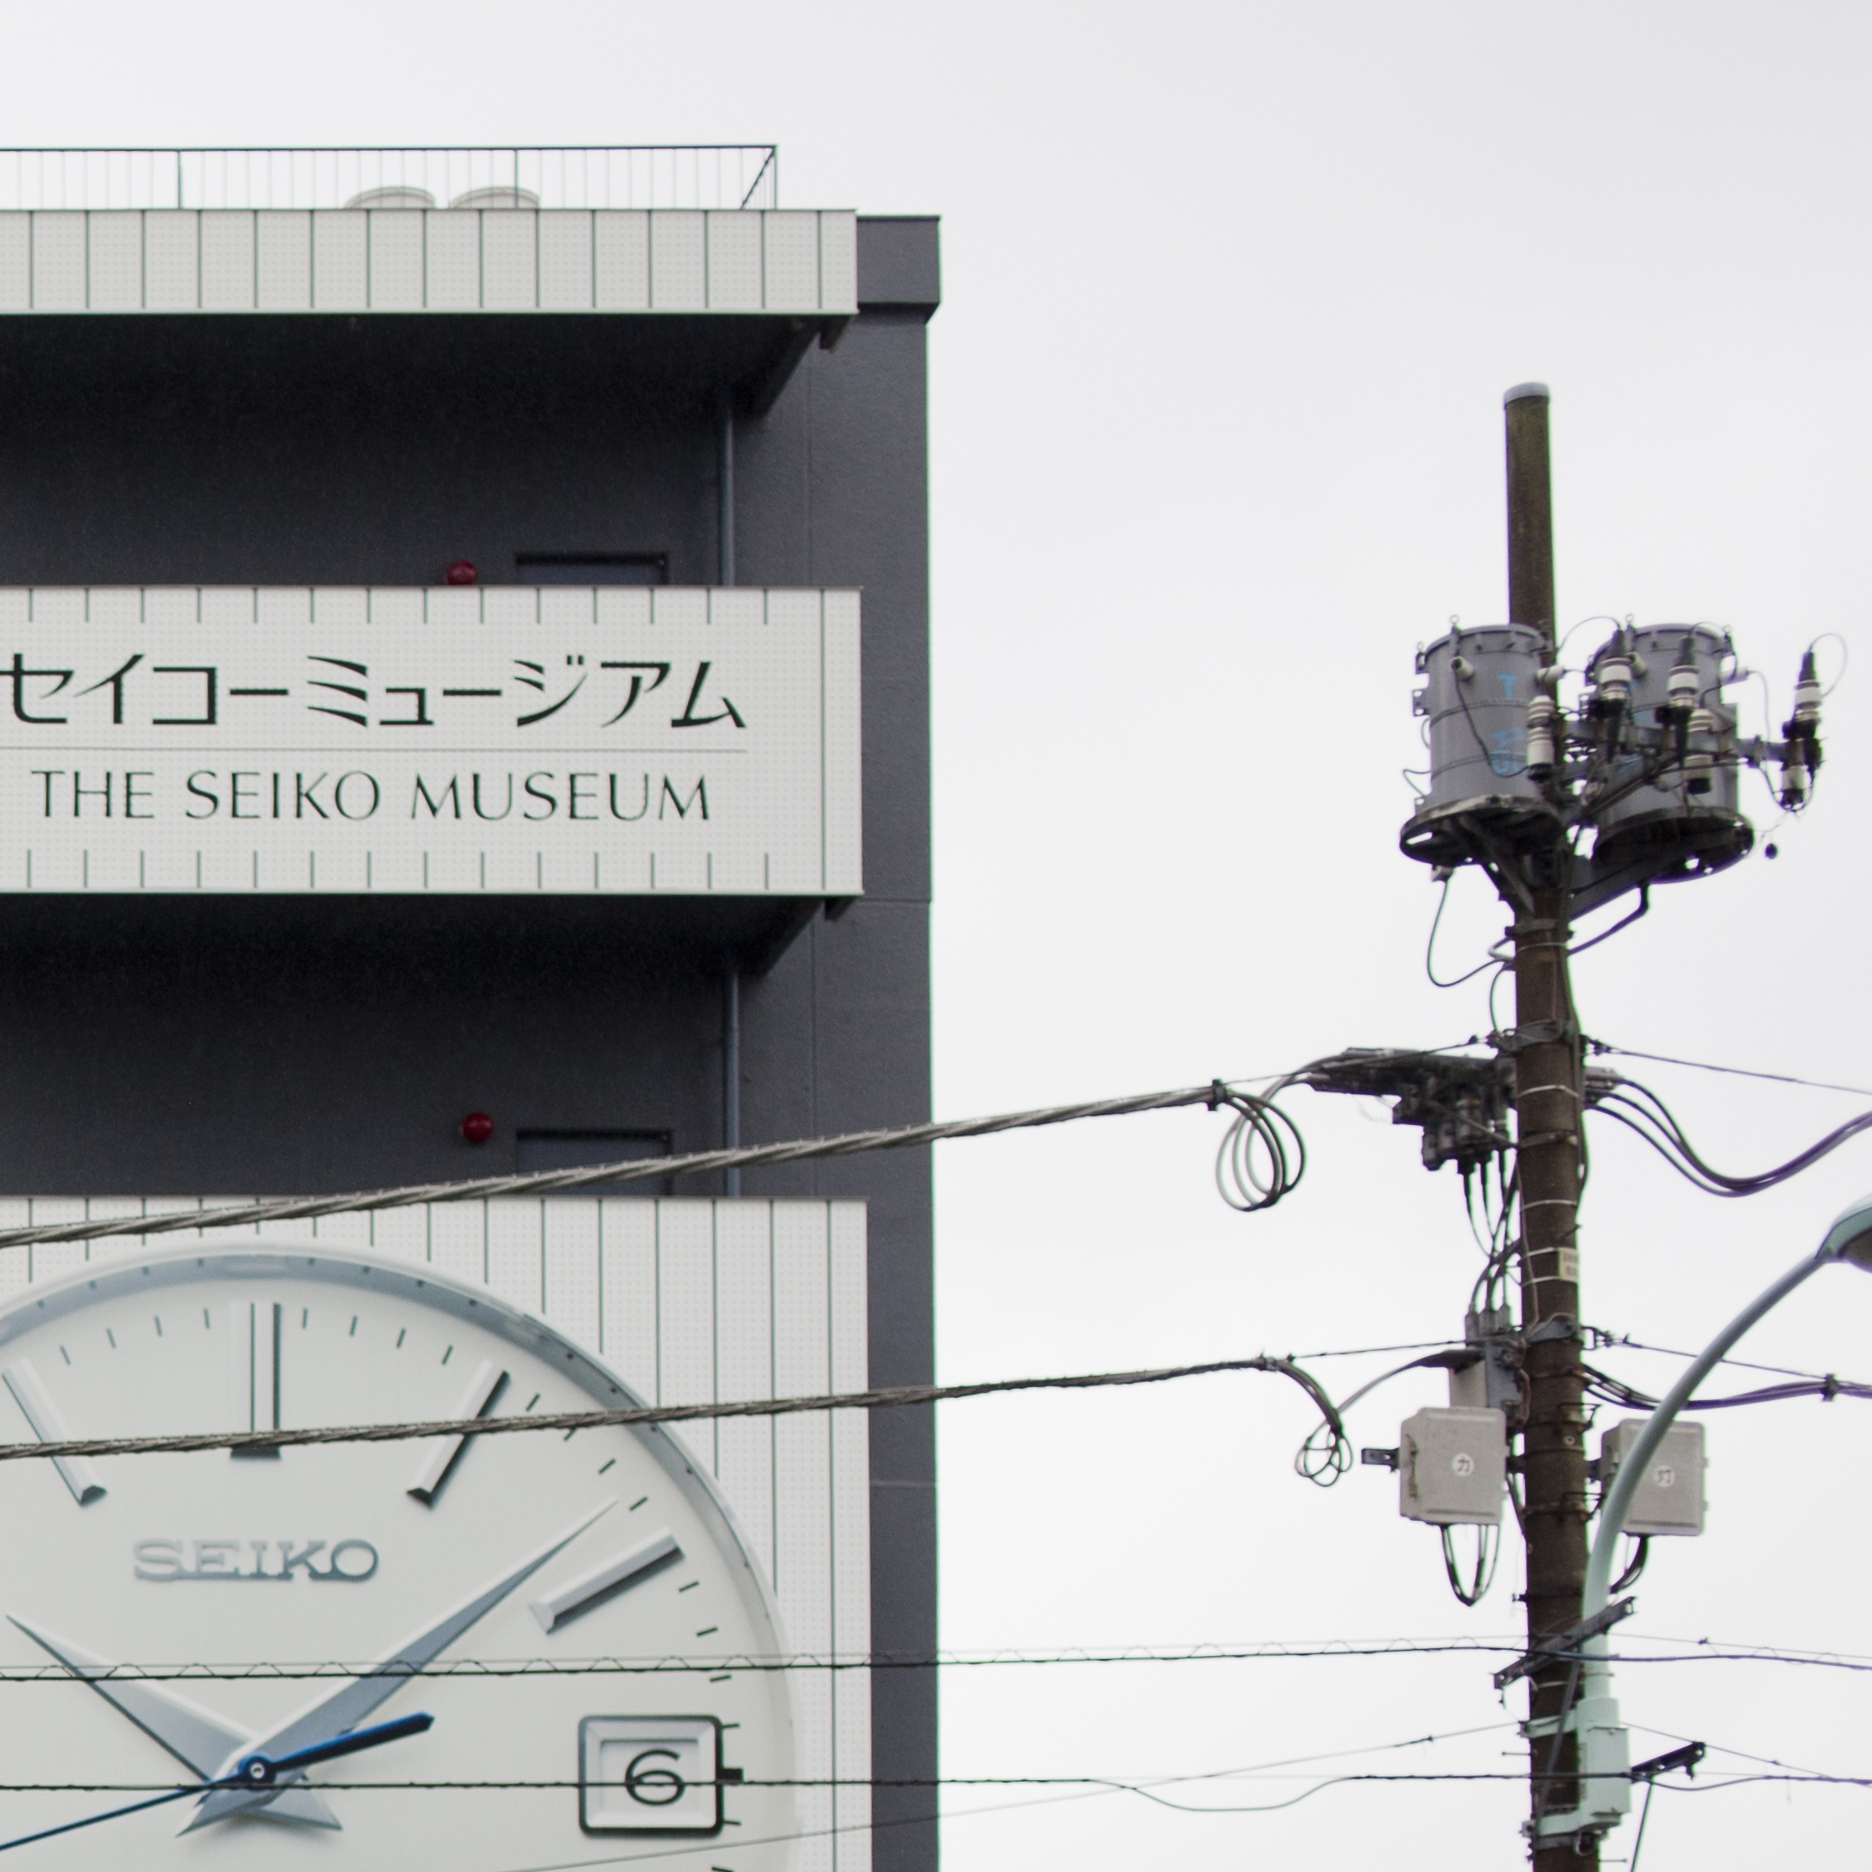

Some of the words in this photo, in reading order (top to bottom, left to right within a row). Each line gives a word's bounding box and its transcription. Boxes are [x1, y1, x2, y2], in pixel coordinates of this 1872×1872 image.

[31, 769, 154, 820] THE
[184, 769, 381, 821] SEIKO
[410, 771, 710, 822] MUSEUM
[132, 1538, 379, 1582] SEIKO
[623, 1749, 687, 1806] 6
